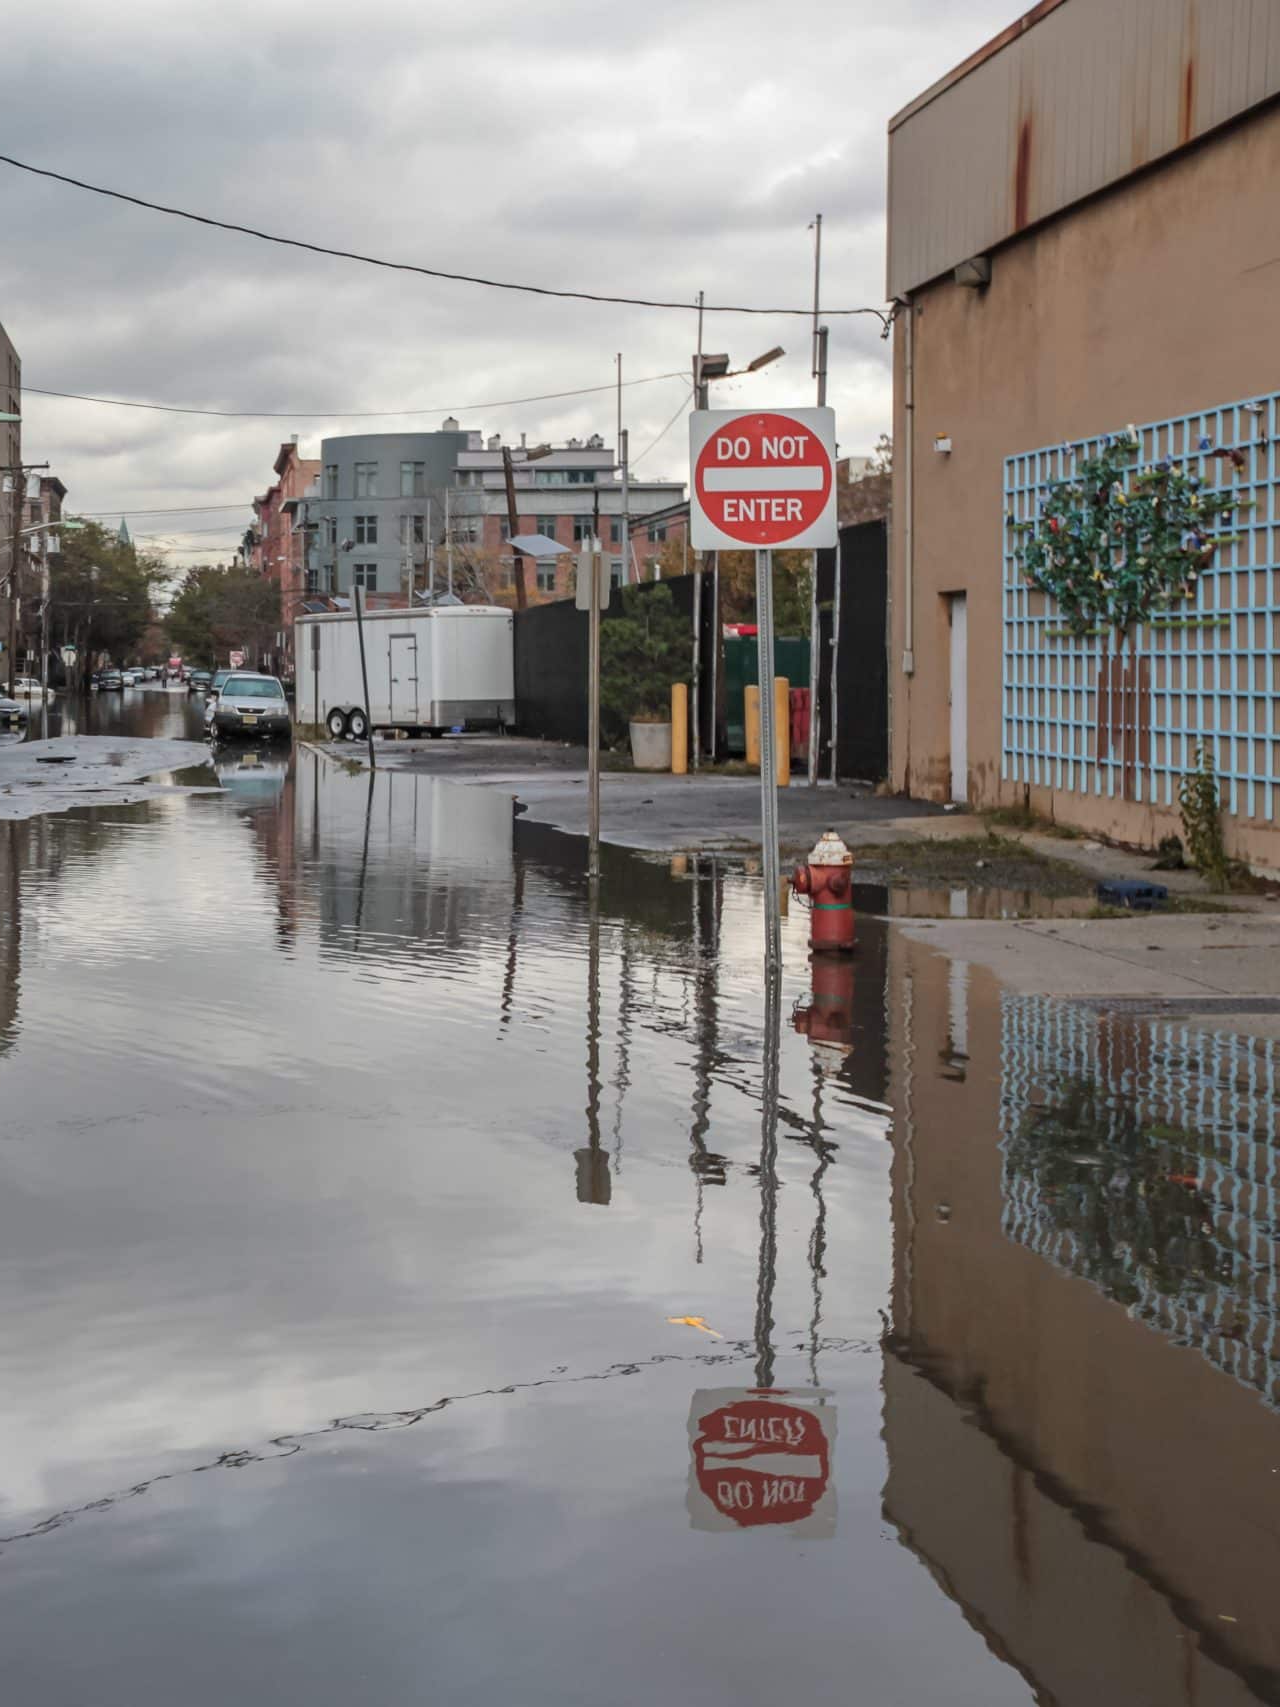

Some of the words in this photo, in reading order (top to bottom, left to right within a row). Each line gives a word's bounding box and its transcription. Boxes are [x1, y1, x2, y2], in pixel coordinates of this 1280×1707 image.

[717, 437, 751, 460] DO
[762, 436, 809, 460] NOT
[723, 499, 803, 522] ENTER
